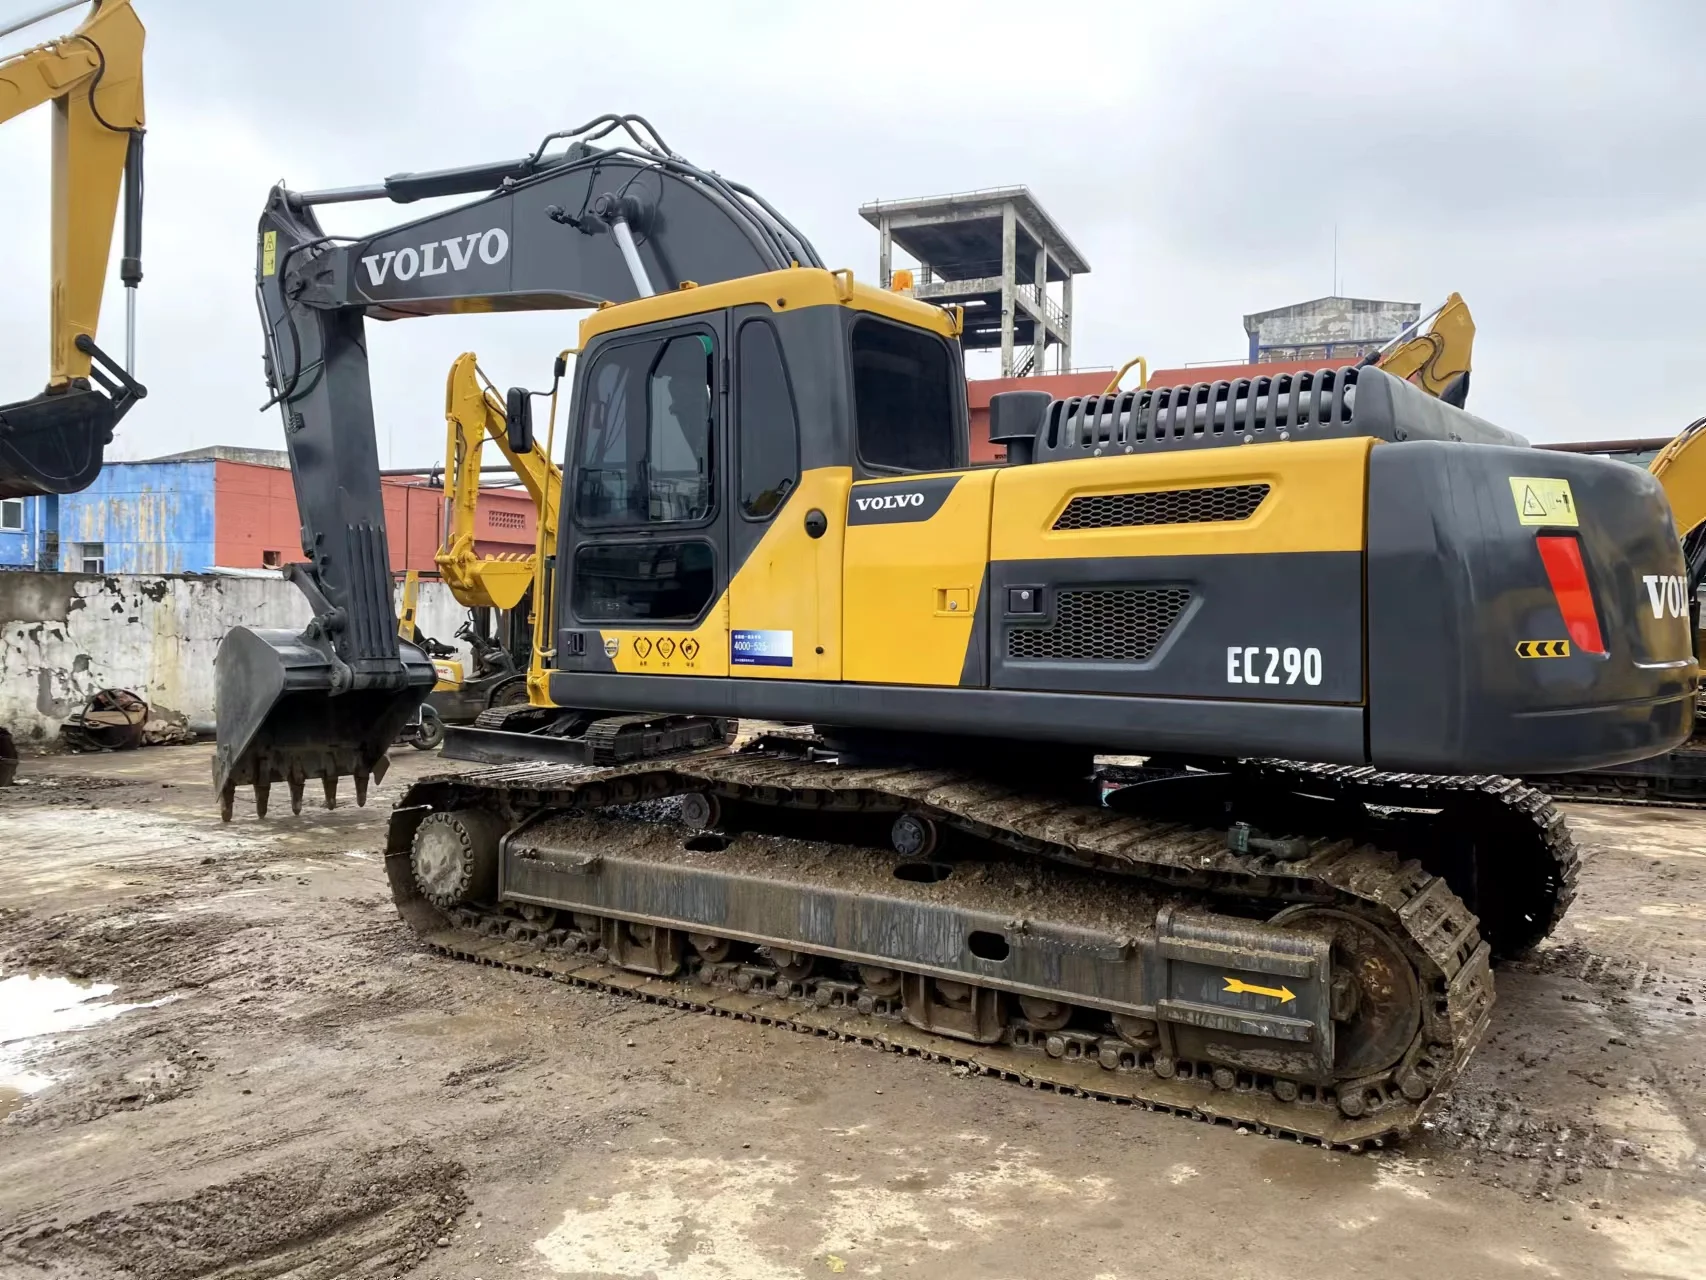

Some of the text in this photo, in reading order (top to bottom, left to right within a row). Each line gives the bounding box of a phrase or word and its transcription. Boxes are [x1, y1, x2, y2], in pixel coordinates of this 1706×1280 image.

[361, 227, 509, 287] VOLVO
[855, 492, 925, 511] VOLVO
[1227, 646, 1323, 686] EC290
